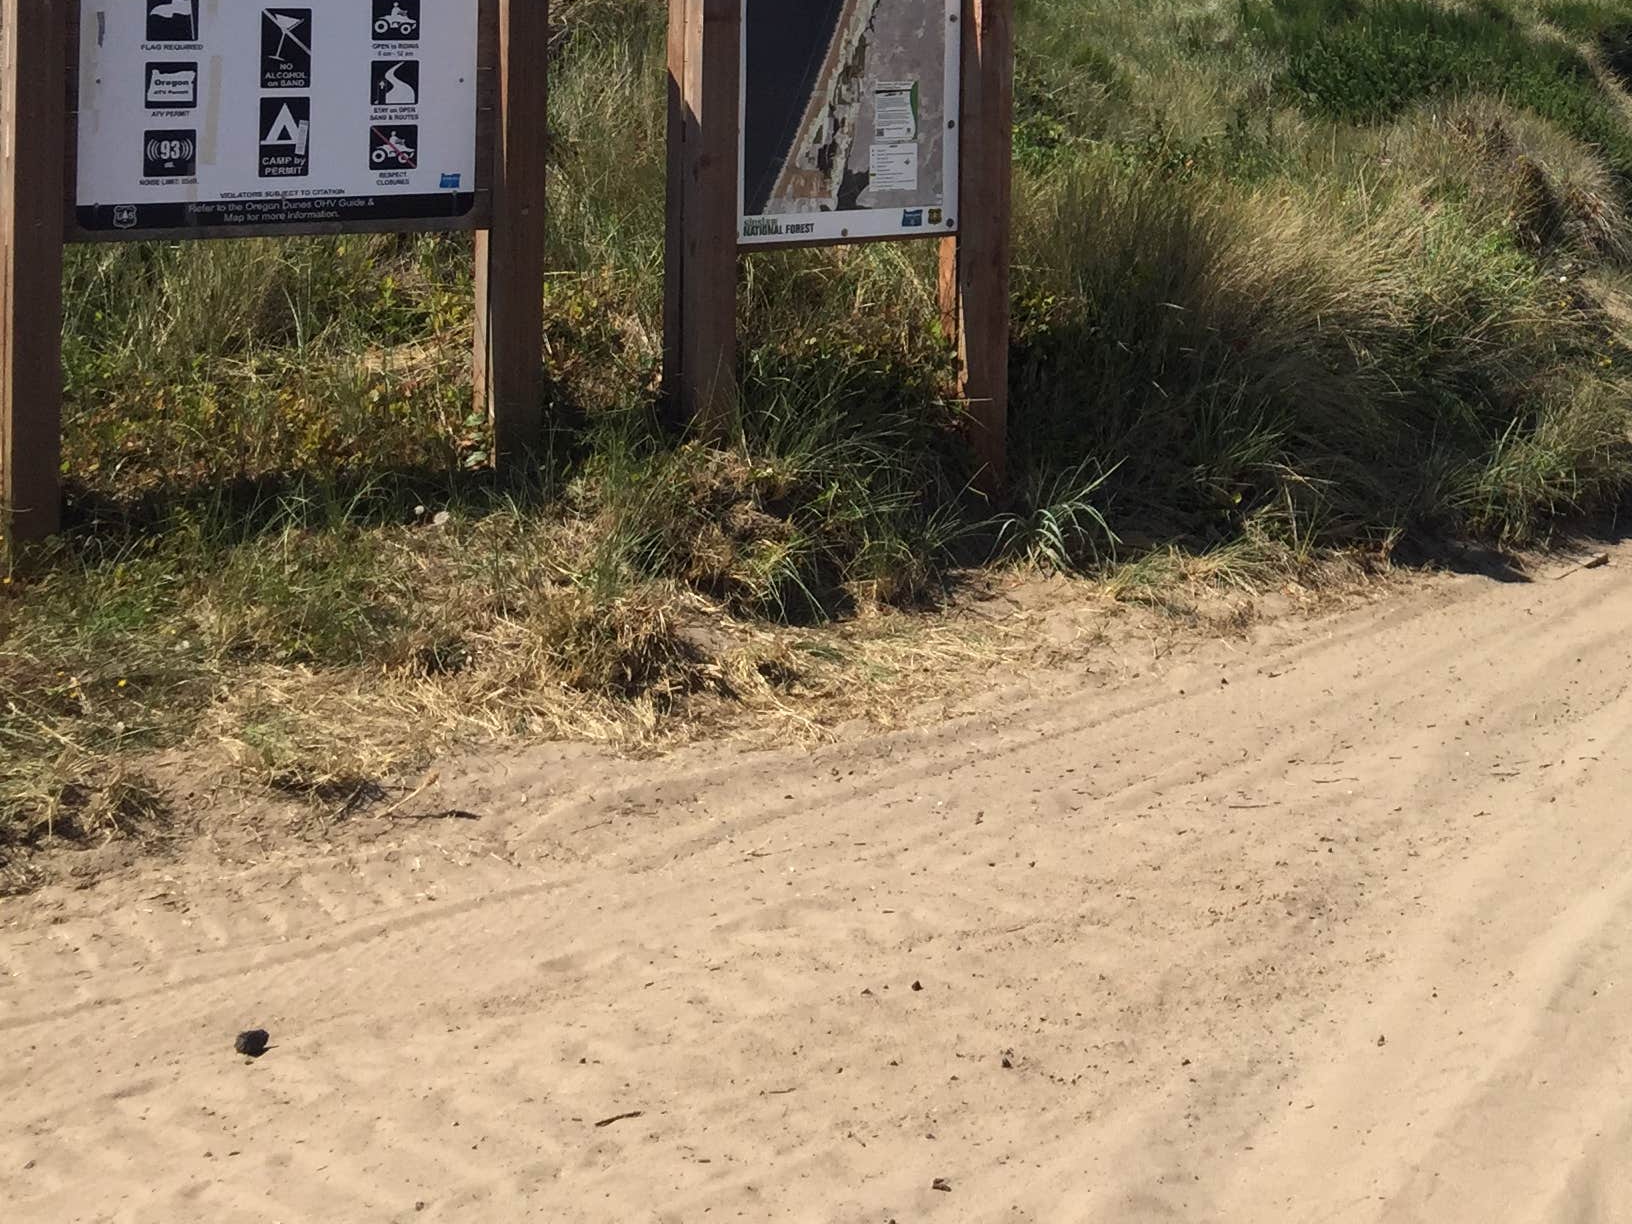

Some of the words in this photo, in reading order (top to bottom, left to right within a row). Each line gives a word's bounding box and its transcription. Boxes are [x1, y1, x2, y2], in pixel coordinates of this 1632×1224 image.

[163, 43, 204, 51] REQUIRED
[280, 63, 293, 71] NO
[265, 71, 306, 79] ALCOHOL
[154, 79, 189, 87] Oregon
[280, 79, 305, 87] SAND
[160, 140, 180, 159] 93
[262, 157, 292, 166] CAMP
[294, 156, 306, 166] by
[265, 166, 302, 176] PERMIT
[376, 178, 410, 186] CLOSURES
[188, 204, 215, 213] Refer
[228, 203, 243, 211] the
[245, 202, 280, 212] Oregon
[282, 200, 312, 209] Dunes
[314, 199, 337, 208] OHV
[339, 198, 366, 207] Guide
[367, 198, 375, 206] &
[223, 213, 245, 224] Map
[246, 212, 260, 221] for
[261, 212, 285, 221] more
[743, 224, 783, 236] NATIONAL
[785, 223, 815, 234] FOREST
